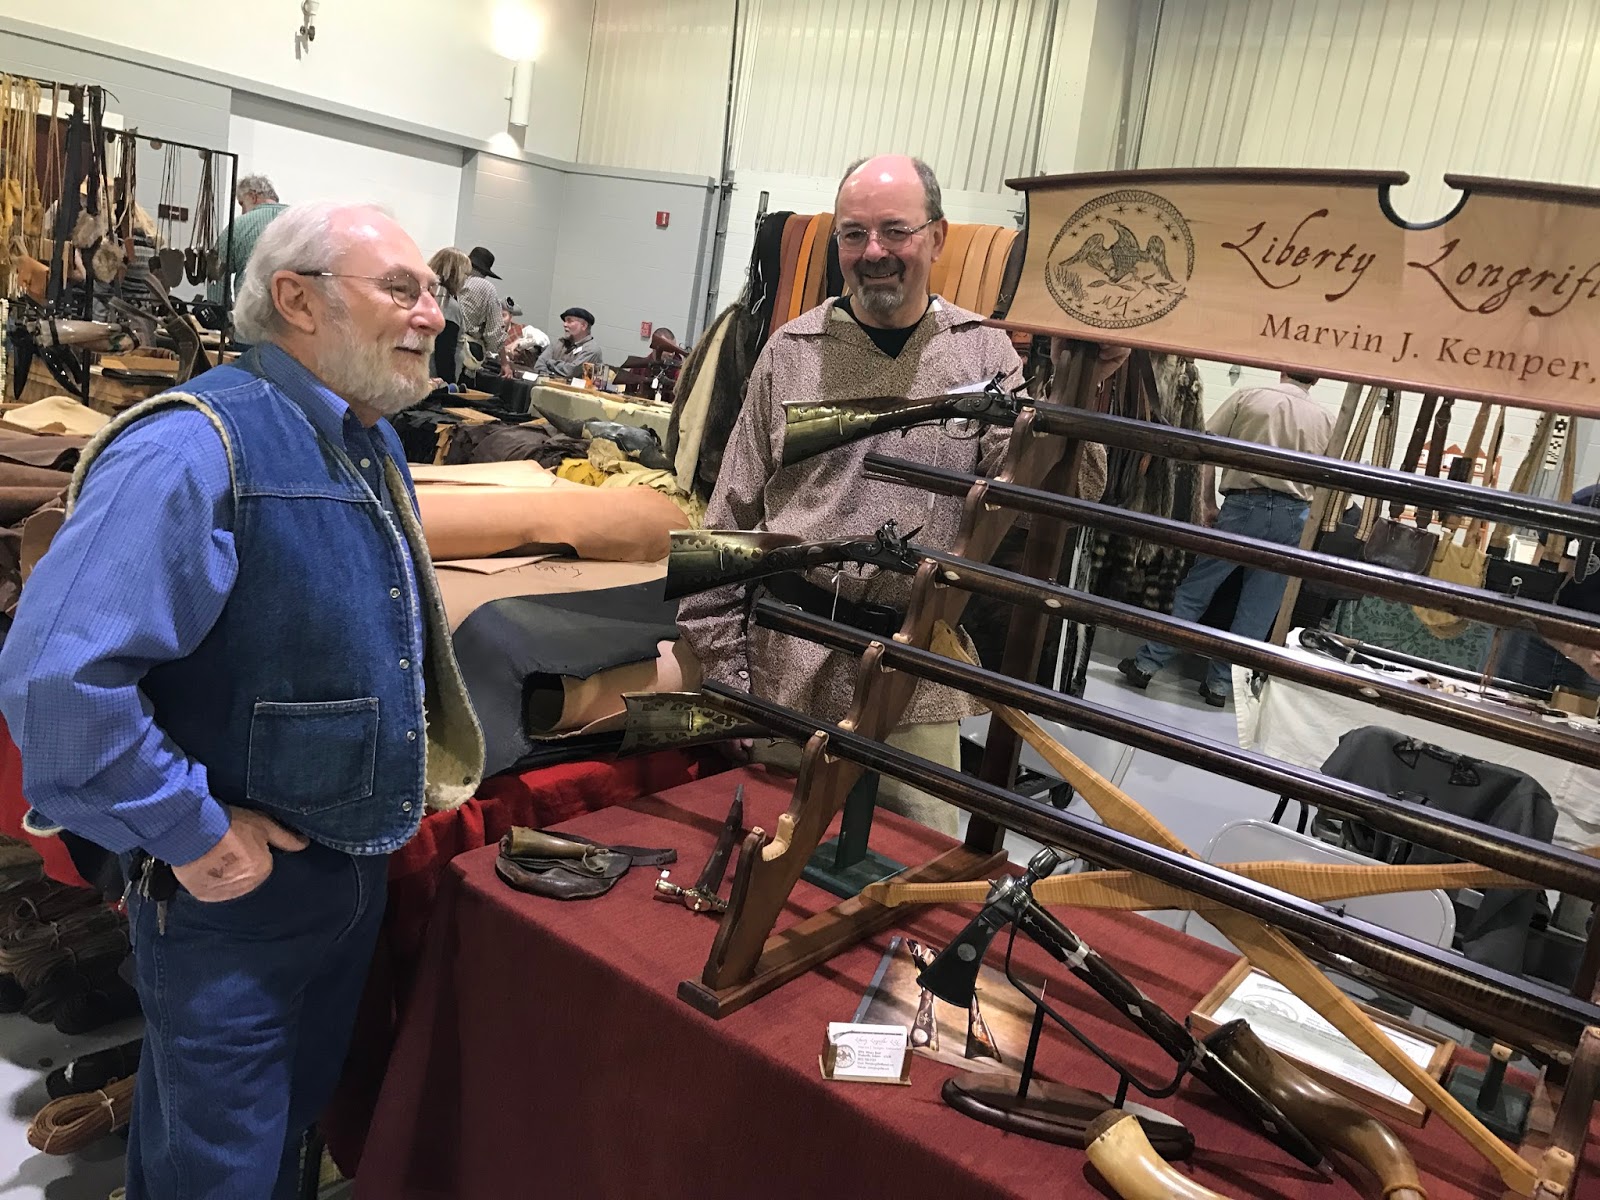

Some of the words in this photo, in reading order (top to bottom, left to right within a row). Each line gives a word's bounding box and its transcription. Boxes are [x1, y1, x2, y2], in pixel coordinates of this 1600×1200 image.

[1222, 209, 1376, 301] Liberty
[1261, 313, 1383, 354] Marvin
[1392, 332, 1419, 362] J.
[1436, 337, 1597, 384] Kemper,
